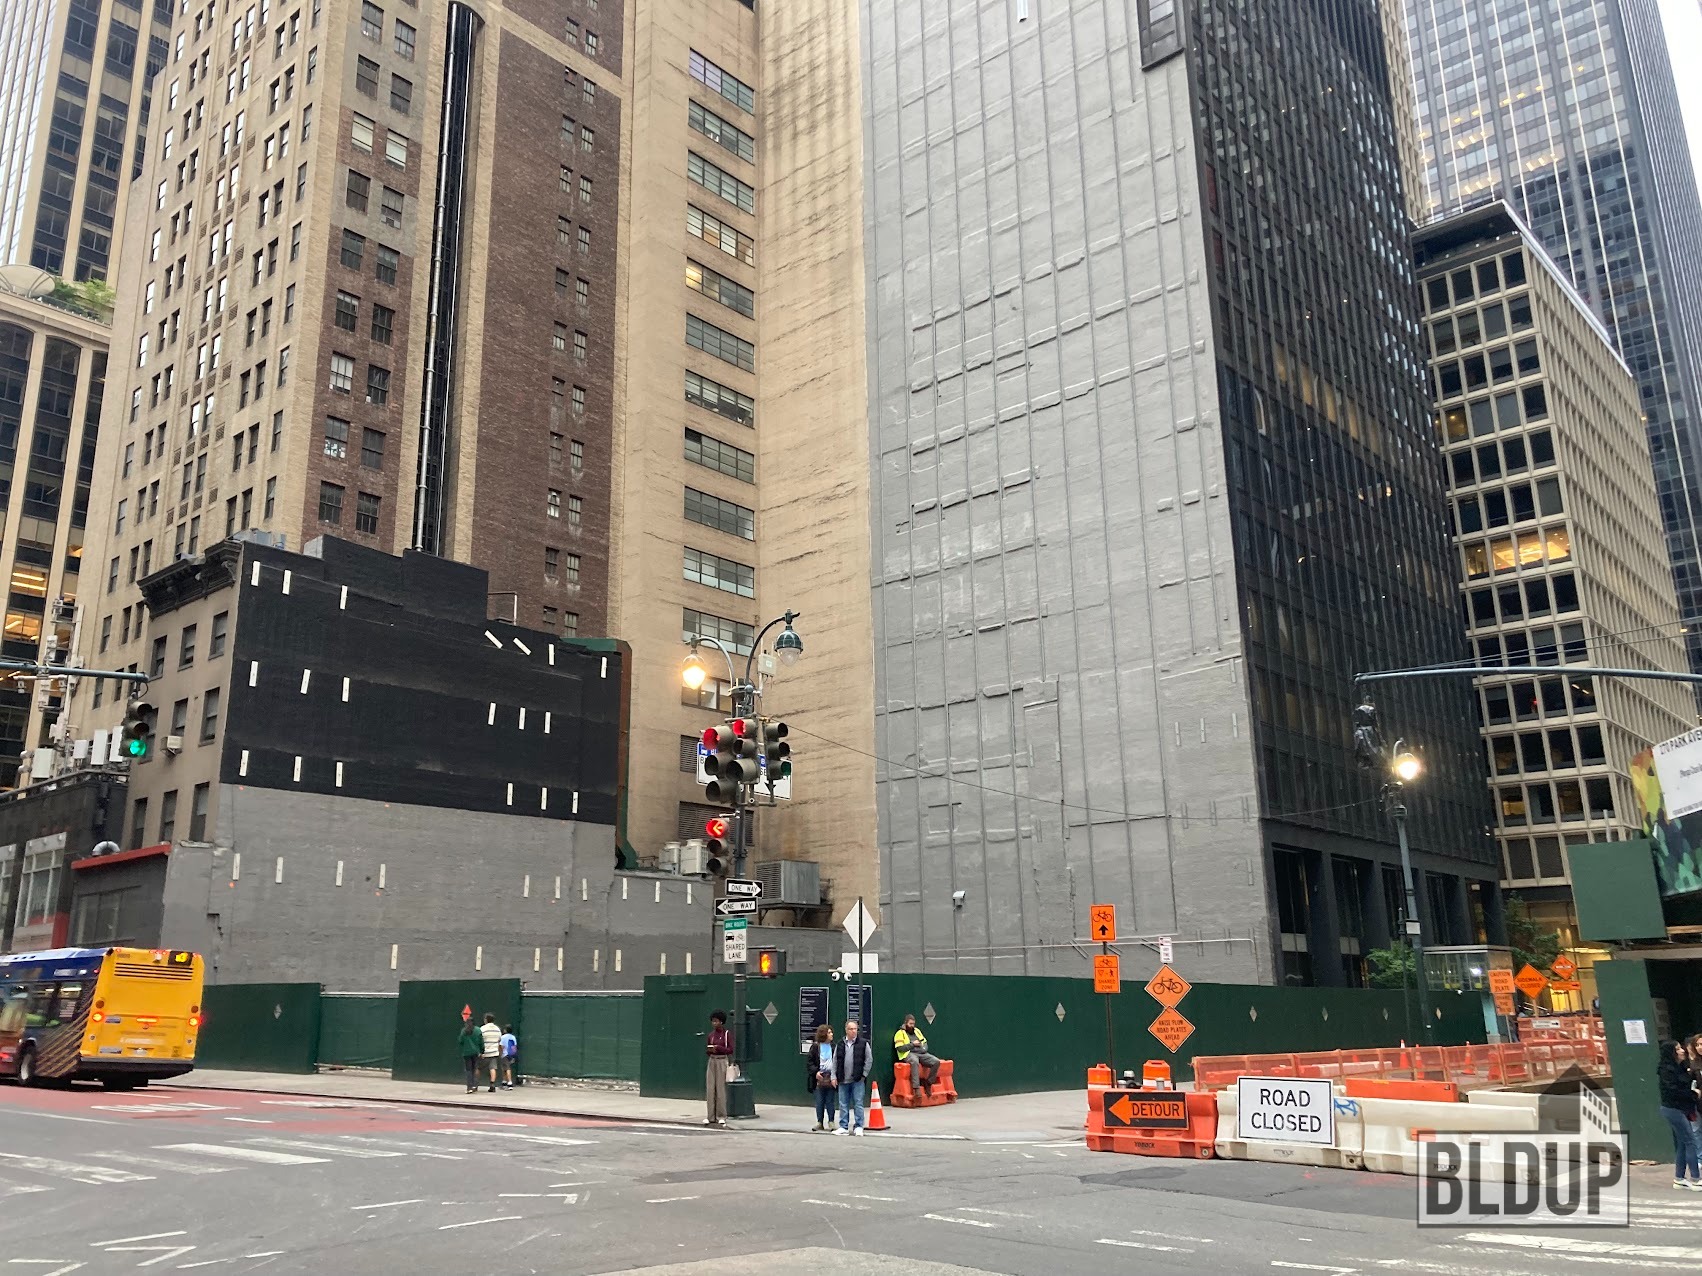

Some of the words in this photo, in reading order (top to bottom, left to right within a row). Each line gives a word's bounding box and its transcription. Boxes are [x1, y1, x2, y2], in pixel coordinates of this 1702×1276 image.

[1670, 735, 1688, 751] PARK
[1688, 729, 1702, 743] AVE
[731, 884, 743, 892] ONE
[746, 885, 758, 893] WAY
[722, 903, 735, 911] ONE
[740, 902, 753, 910] WAY
[725, 943, 745, 952] SHARED
[728, 952, 742, 960] LANE
[1259, 1088, 1311, 1108] ROAD
[1132, 1102, 1181, 1117] DETOUR
[1250, 1111, 1323, 1133] CLOSED
